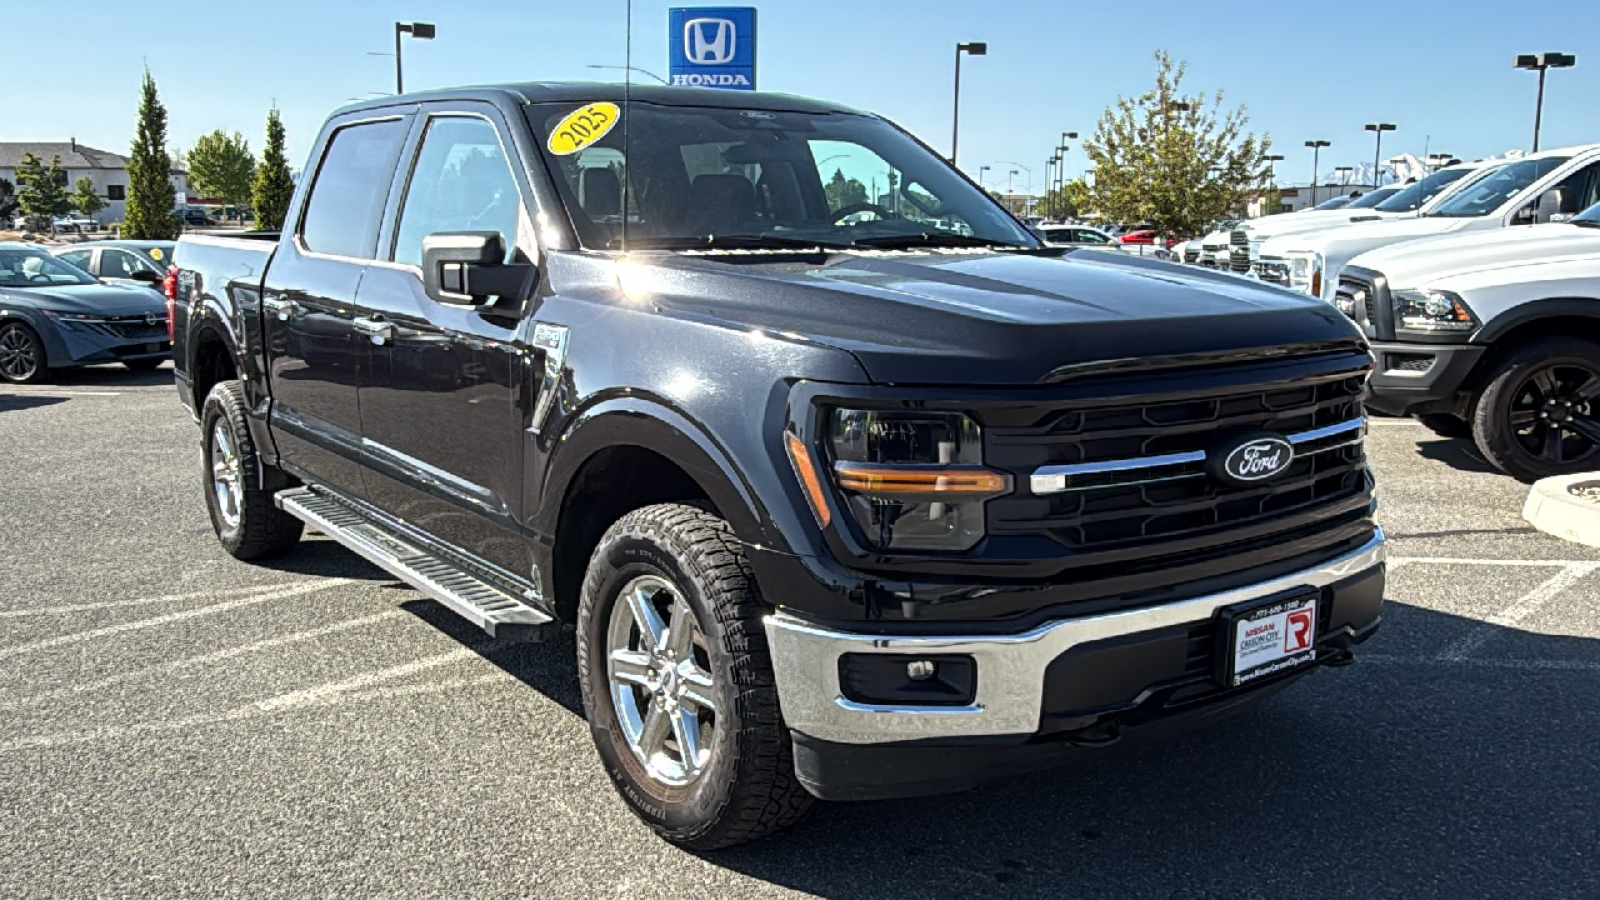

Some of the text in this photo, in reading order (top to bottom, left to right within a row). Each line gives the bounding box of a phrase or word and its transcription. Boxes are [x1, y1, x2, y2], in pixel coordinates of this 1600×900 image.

[672, 74, 751, 86] HONDA
[560, 107, 608, 147] 2025
[1239, 444, 1281, 475] Ford
[1245, 622, 1275, 638] NISSAN
[1265, 629, 1280, 642] CITY
[623, 785, 666, 820] TERRITORY
